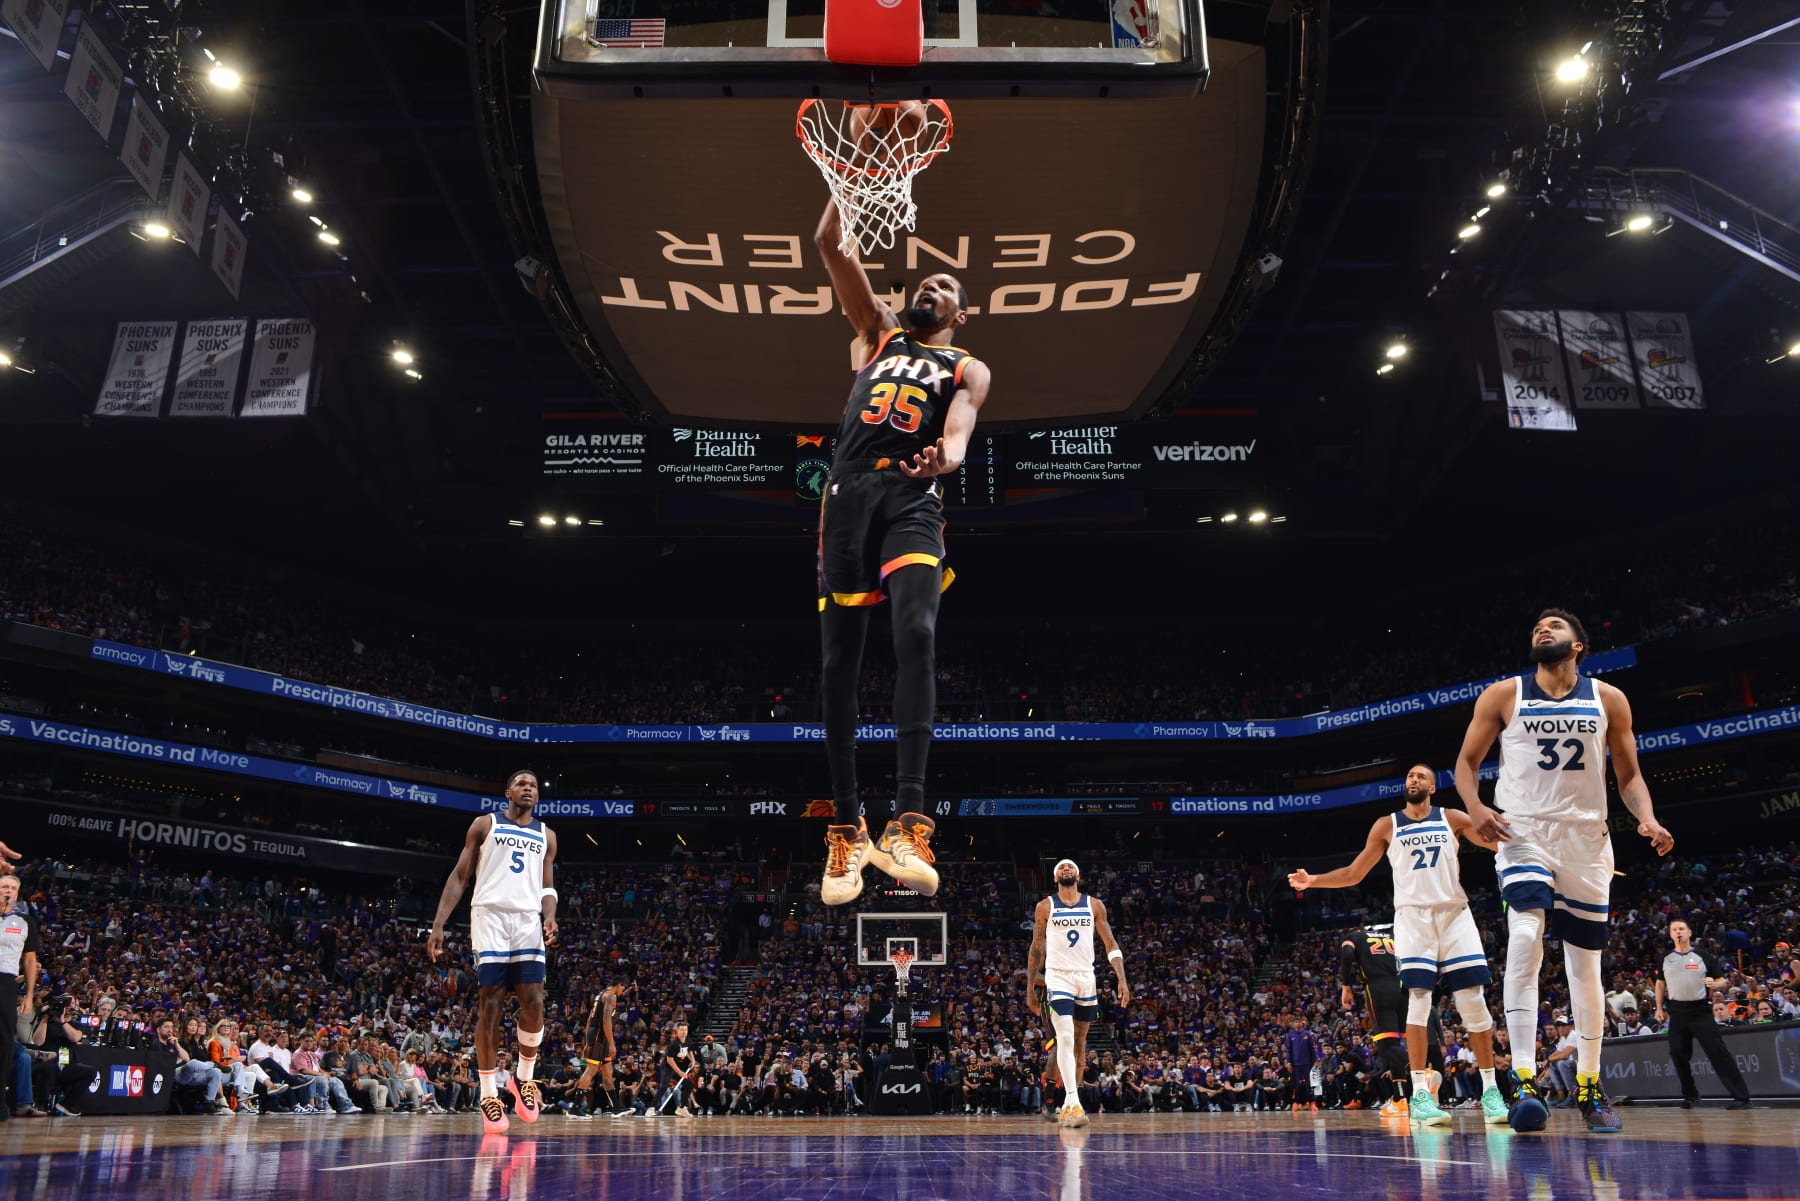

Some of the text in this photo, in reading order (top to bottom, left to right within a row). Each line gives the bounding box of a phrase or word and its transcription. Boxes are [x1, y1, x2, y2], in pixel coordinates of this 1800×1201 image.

[119, 325, 173, 338] PHOENIX
[189, 324, 242, 337] PHOENIX
[260, 323, 312, 336] PHOENIX
[127, 340, 158, 352] SUNS
[196, 339, 229, 351] SUNS
[268, 337, 299, 349] SUNS
[128, 369, 145, 378] 1976
[199, 368, 217, 377] 1993
[270, 367, 288, 376] 2021
[870, 354, 953, 395] PHX
[115, 381, 153, 389] WESTERN
[187, 380, 224, 388] WESTERN
[259, 378, 296, 387] WESTERN
[105, 391, 158, 400] CONFERENCE
[178, 391, 231, 400] CONFERENCE
[251, 389, 301, 398] CONFERENCE
[1514, 385, 1560, 400] 2014
[1582, 387, 1629, 401] 2009
[1651, 385, 1696, 400] 2007
[104, 402, 153, 412] CHAMPIONS
[178, 402, 224, 411] CHAMPIONS
[251, 400, 297, 409] CHAMPIONS
[861, 382, 928, 433] 35
[546, 434, 644, 446] GILA RIVER
[694, 441, 757, 457] Health
[1050, 439, 1113, 455] Health
[1153, 441, 1247, 461] verizon
[658, 463, 784, 473] Official Health Care Partner
[1016, 461, 1141, 470] Official Health Care Partner
[675, 473, 766, 482] of the Phoenix Suns
[1034, 471, 1125, 480] of the Phoenix Suns
[92, 645, 530, 740] armacy fry's Prescriptions, Vaccinations and
[1153, 726, 1208, 737] Pharmacy
[1244, 722, 1276, 738] fry's
[1317, 697, 1425, 729] Prescriptions,
[626, 728, 682, 741] Pharmacy
[718, 726, 750, 741] fry's
[1024, 724, 1056, 738] and
[1523, 720, 1597, 734] WOLVES
[30, 721, 163, 757] Vaccinations
[169, 747, 195, 762] nd
[200, 748, 249, 768] More
[1537, 738, 1585, 770] 32
[315, 771, 372, 792] Pharmacy
[407, 786, 437, 804] fry's
[604, 802, 634, 814] Vac
[643, 803, 655, 814] 17
[750, 801, 787, 815] PHX
[936, 801, 951, 816] 49
[1152, 802, 1163, 812] 17
[1172, 797, 1248, 811] cinations
[1252, 798, 1274, 811] nd
[1279, 793, 1321, 808] More
[48, 813, 306, 857] 100% AGAVE HORNITOS TEQUILA
[1400, 834, 1448, 848] WOLVES
[494, 836, 542, 854] WOLVES
[509, 850, 525, 873] 5
[1411, 846, 1441, 870] 27
[1052, 918, 1091, 927] WOLVES
[1066, 929, 1080, 948] 9
[1366, 937, 1396, 954] 20
[897, 1022, 907, 1030] GET
[1643, 1060, 1662, 1078] The
[1736, 1054, 1760, 1073] EV9
[112, 1070, 124, 1089] NBA
